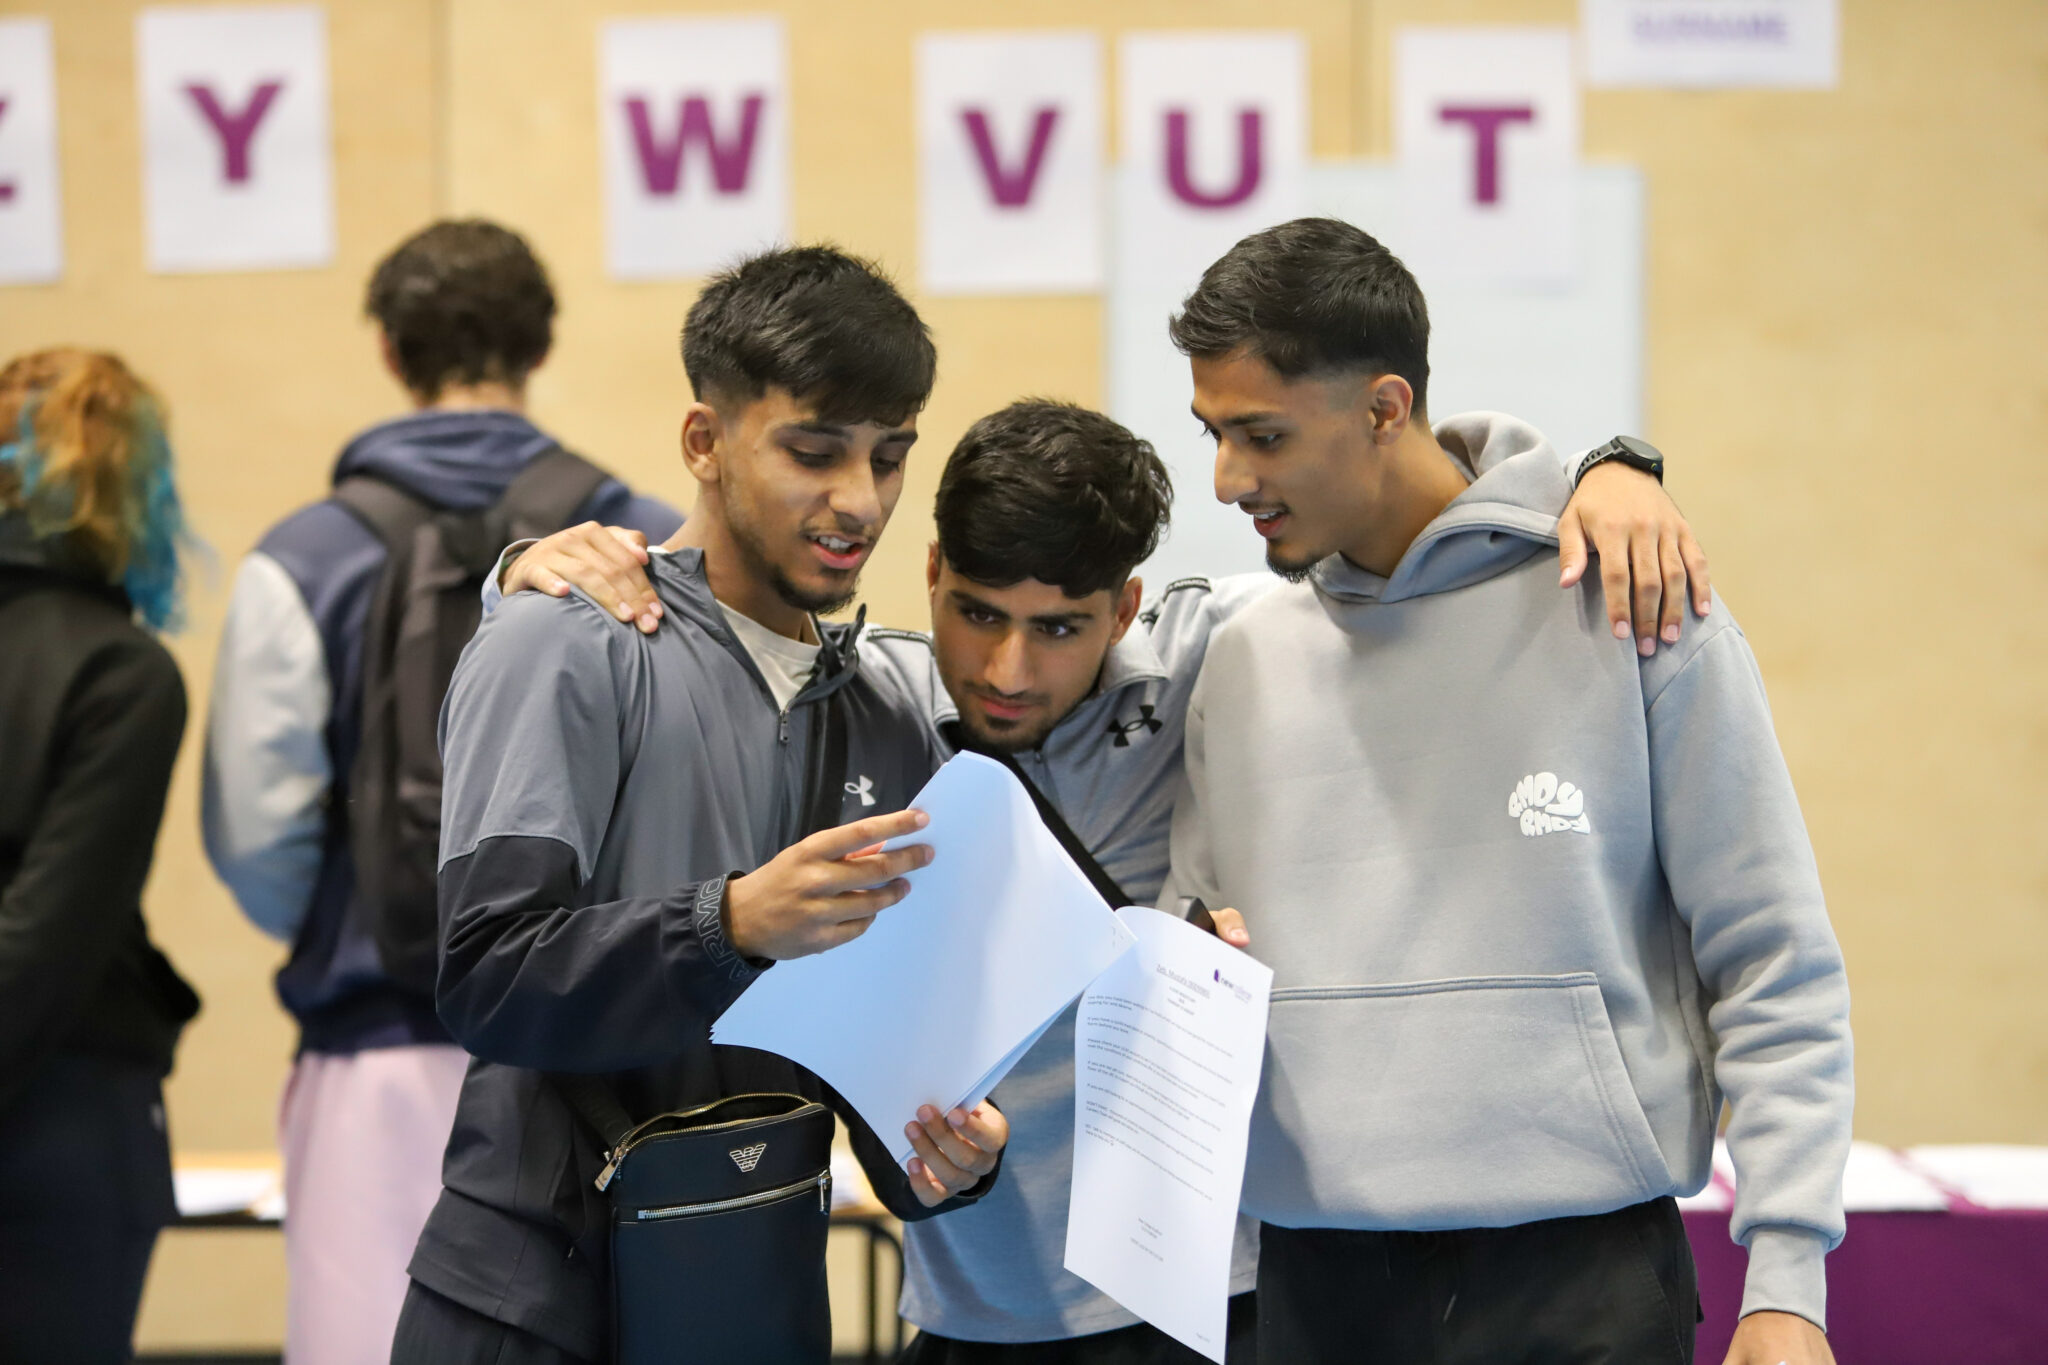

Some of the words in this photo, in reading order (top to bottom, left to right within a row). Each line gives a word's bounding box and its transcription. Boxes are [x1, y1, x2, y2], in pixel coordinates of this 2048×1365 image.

[186, 81, 281, 183] Y
[623, 93, 764, 197] W
[962, 107, 1059, 209] V
[1164, 109, 1264, 211] U
[1438, 105, 1535, 206] T
